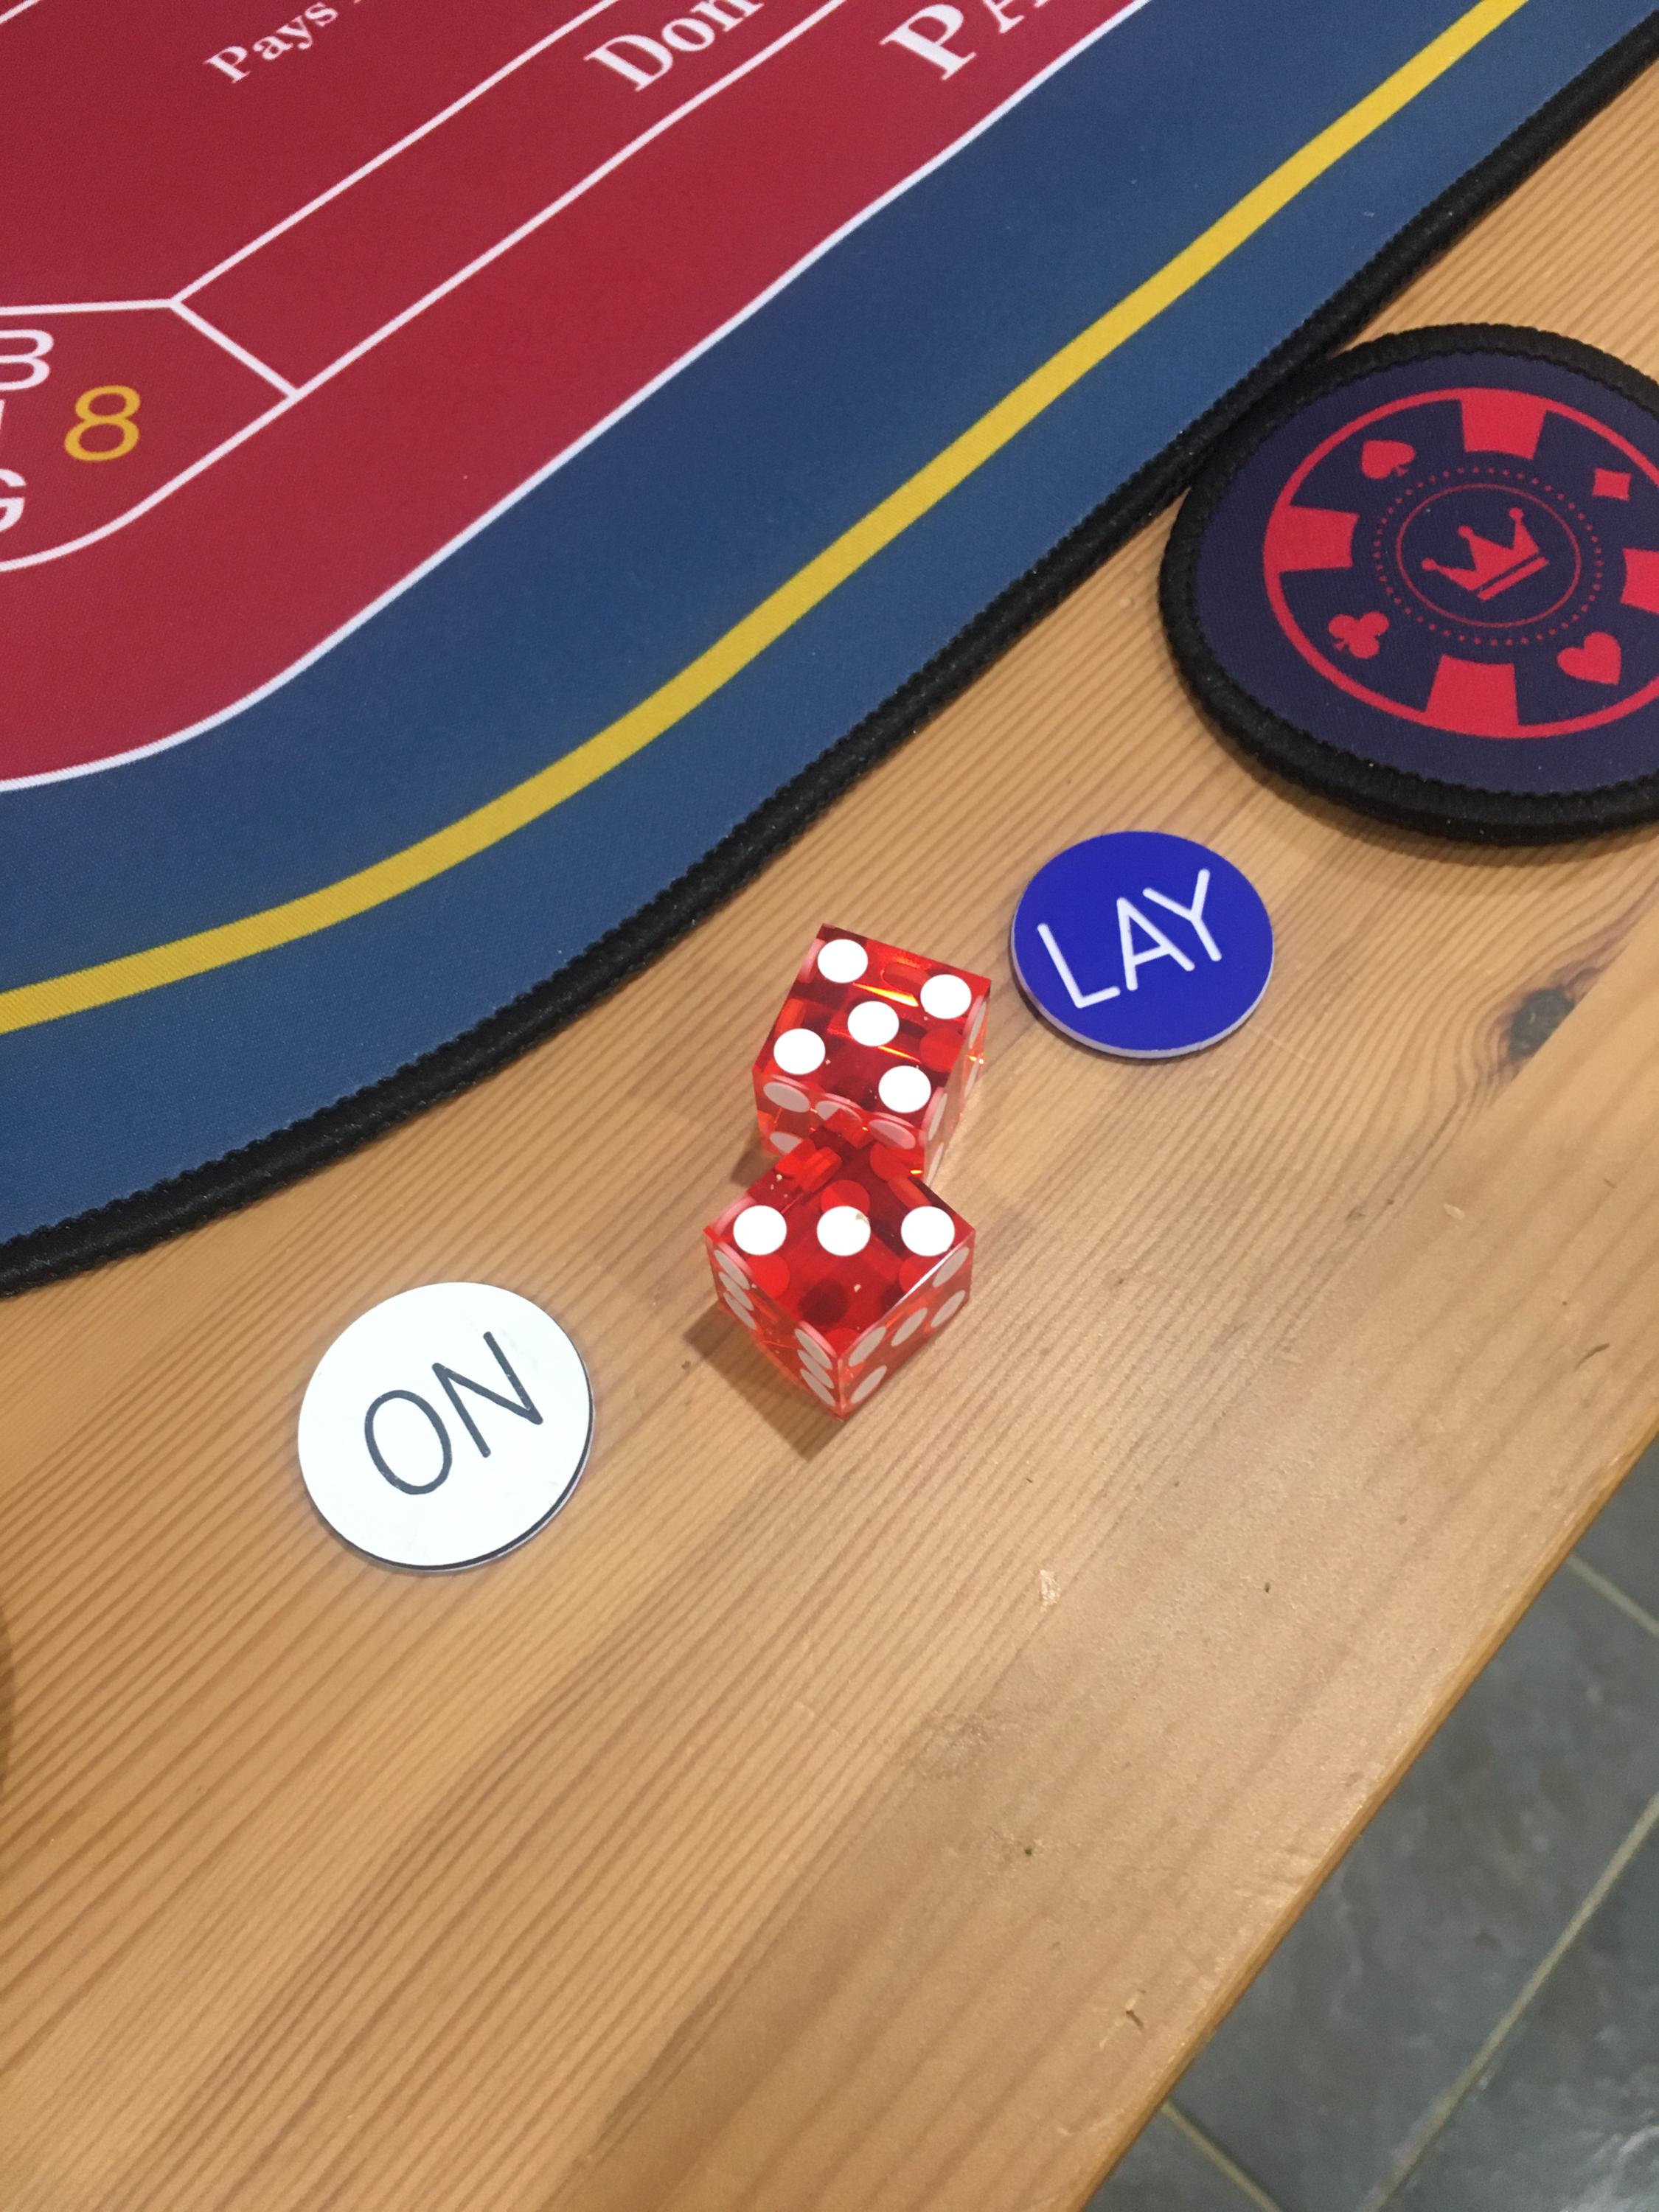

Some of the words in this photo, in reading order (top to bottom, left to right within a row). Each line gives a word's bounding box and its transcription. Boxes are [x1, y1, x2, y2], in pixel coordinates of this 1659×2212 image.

[203, 2, 338, 84] Pays
[64, 385, 141, 462] 8
[1037, 869, 1222, 1009] LAY
[364, 1331, 543, 1495] ON
